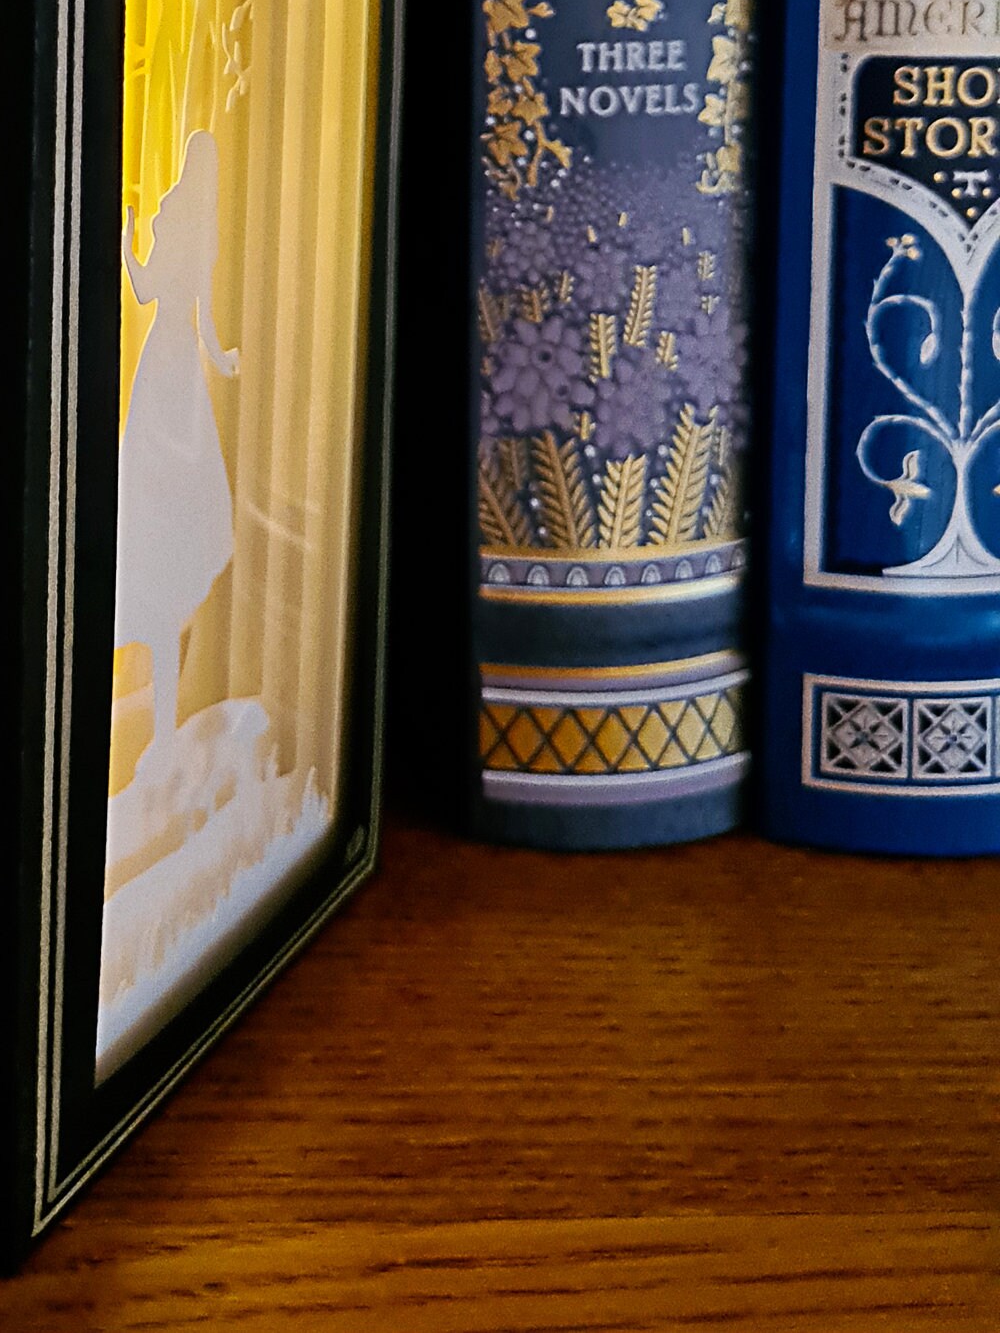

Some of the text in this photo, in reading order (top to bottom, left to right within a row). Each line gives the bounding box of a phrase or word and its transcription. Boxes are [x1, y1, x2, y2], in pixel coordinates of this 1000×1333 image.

[576, 38, 688, 73] THREE
[559, 83, 701, 117] NOVELS
[893, 66, 1000, 108] SHO
